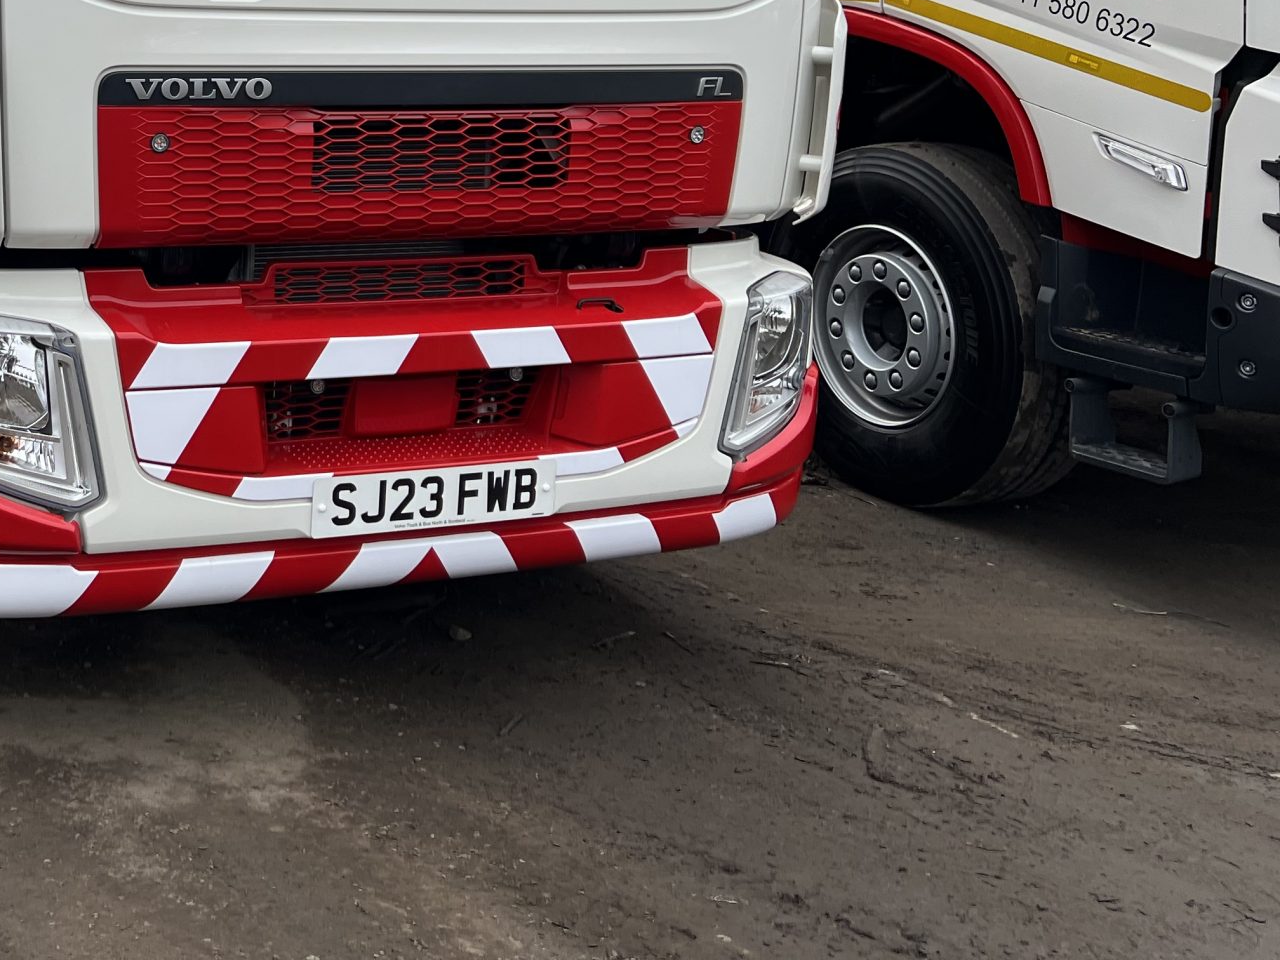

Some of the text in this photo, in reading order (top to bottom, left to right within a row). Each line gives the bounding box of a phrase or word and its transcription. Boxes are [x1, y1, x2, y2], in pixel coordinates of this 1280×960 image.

[1095, 8, 1156, 48] 6322
[125, 77, 273, 100] VOLVO
[696, 76, 731, 98] FL
[331, 467, 538, 526] SJ23 FWB
